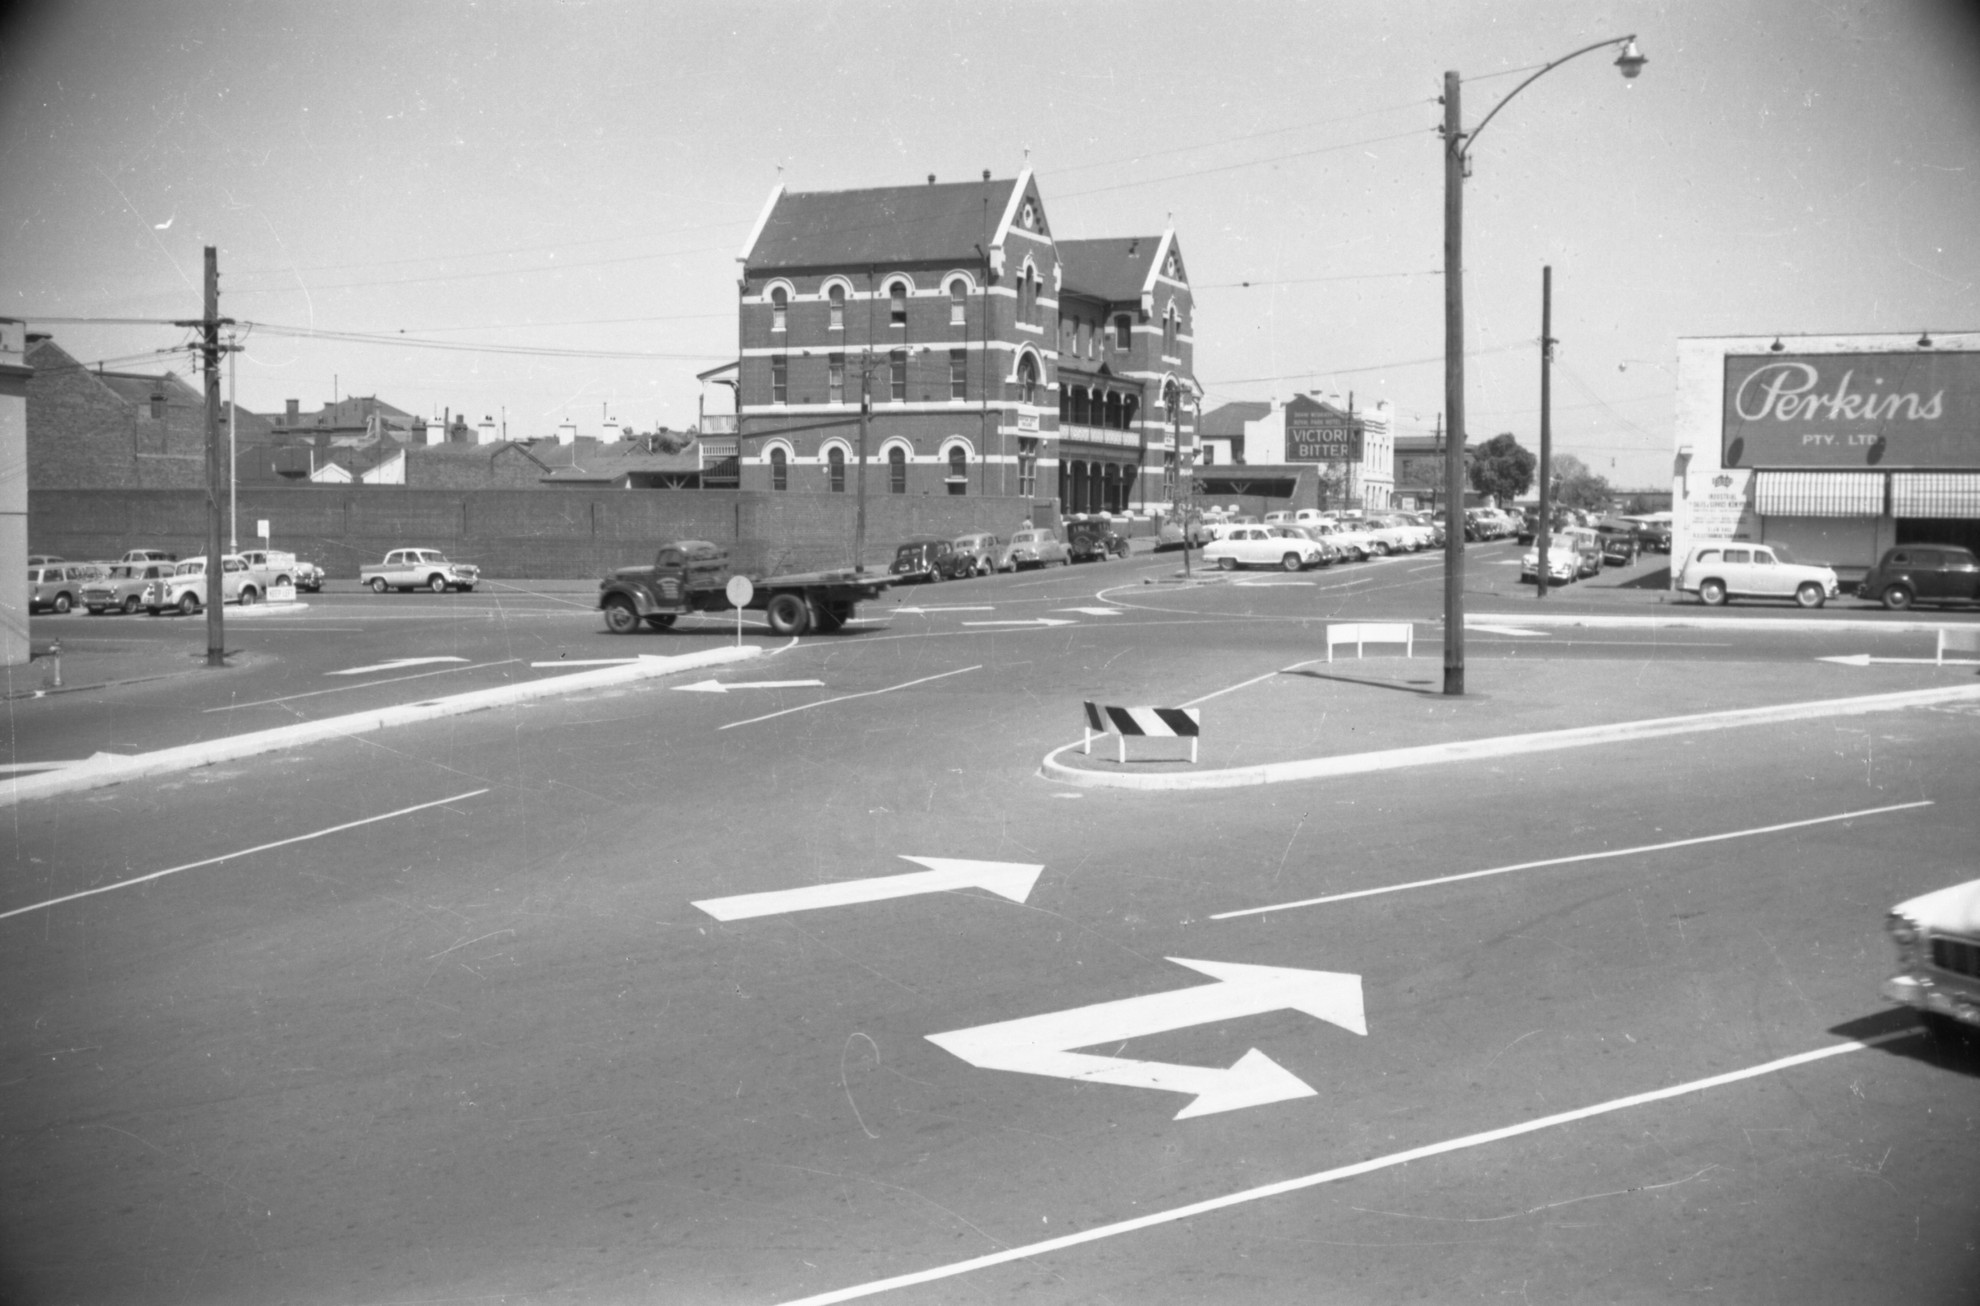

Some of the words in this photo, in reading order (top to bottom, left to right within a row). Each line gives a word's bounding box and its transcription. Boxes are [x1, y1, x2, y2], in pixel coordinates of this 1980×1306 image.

[1736, 362, 1945, 421] Perkins
[1802, 434, 1840, 446] PTY.
[1299, 444, 1348, 457] BITTER
